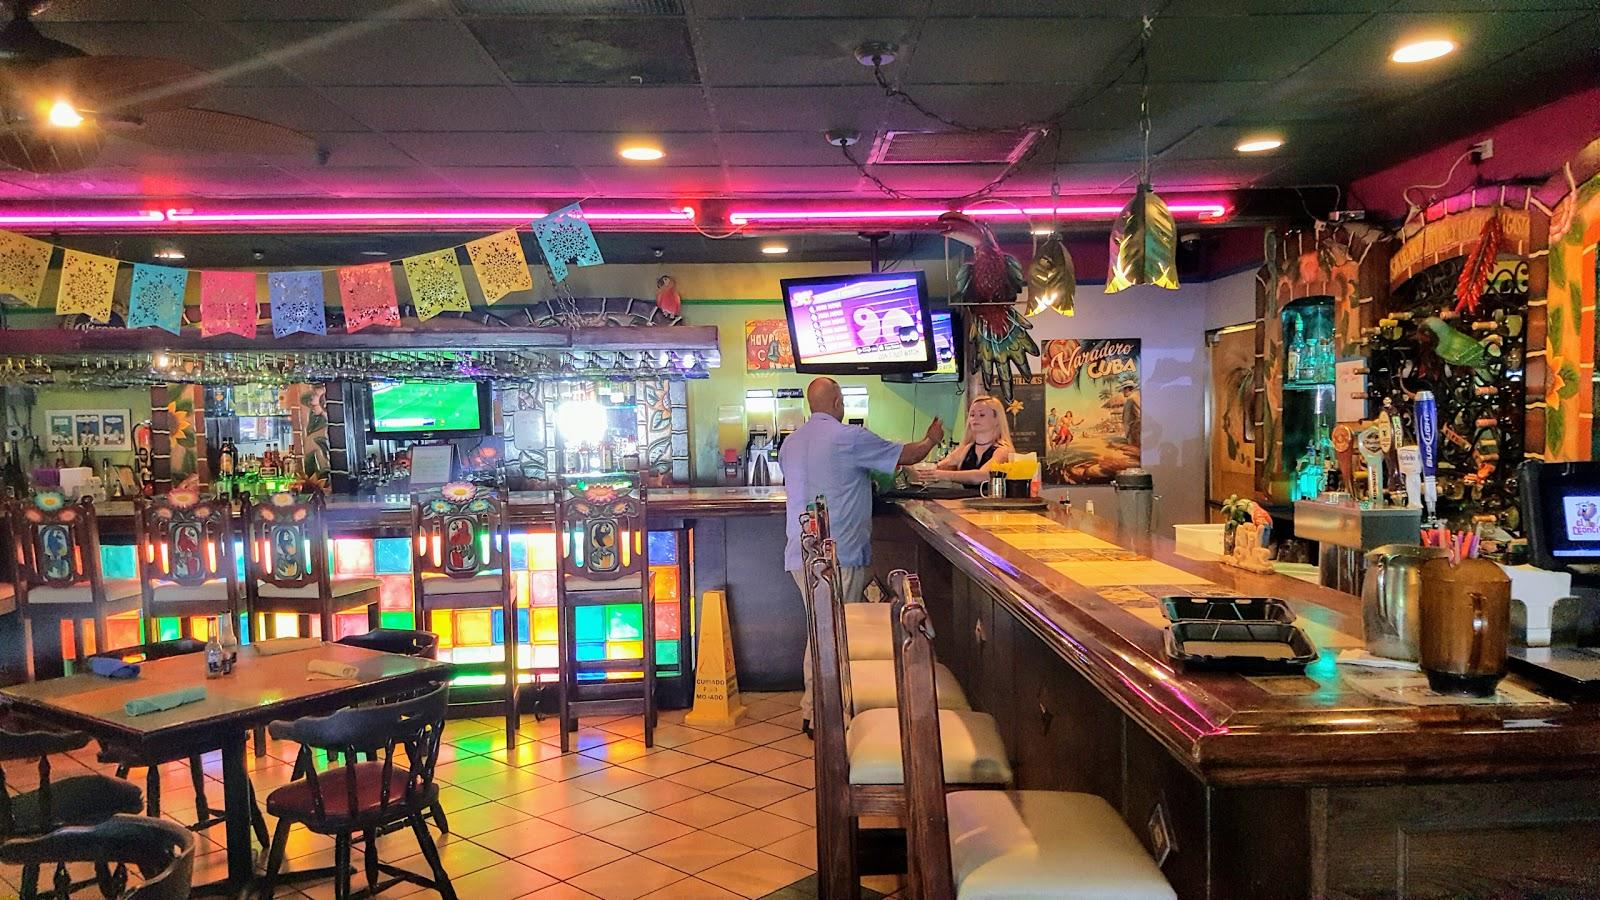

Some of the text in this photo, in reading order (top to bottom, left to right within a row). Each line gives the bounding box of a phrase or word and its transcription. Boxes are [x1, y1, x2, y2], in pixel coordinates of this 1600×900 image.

[1050, 341, 1135, 377] Varadero
[1087, 358, 1136, 379] CUBA
[1423, 412, 1433, 468] BUD LIGHT
